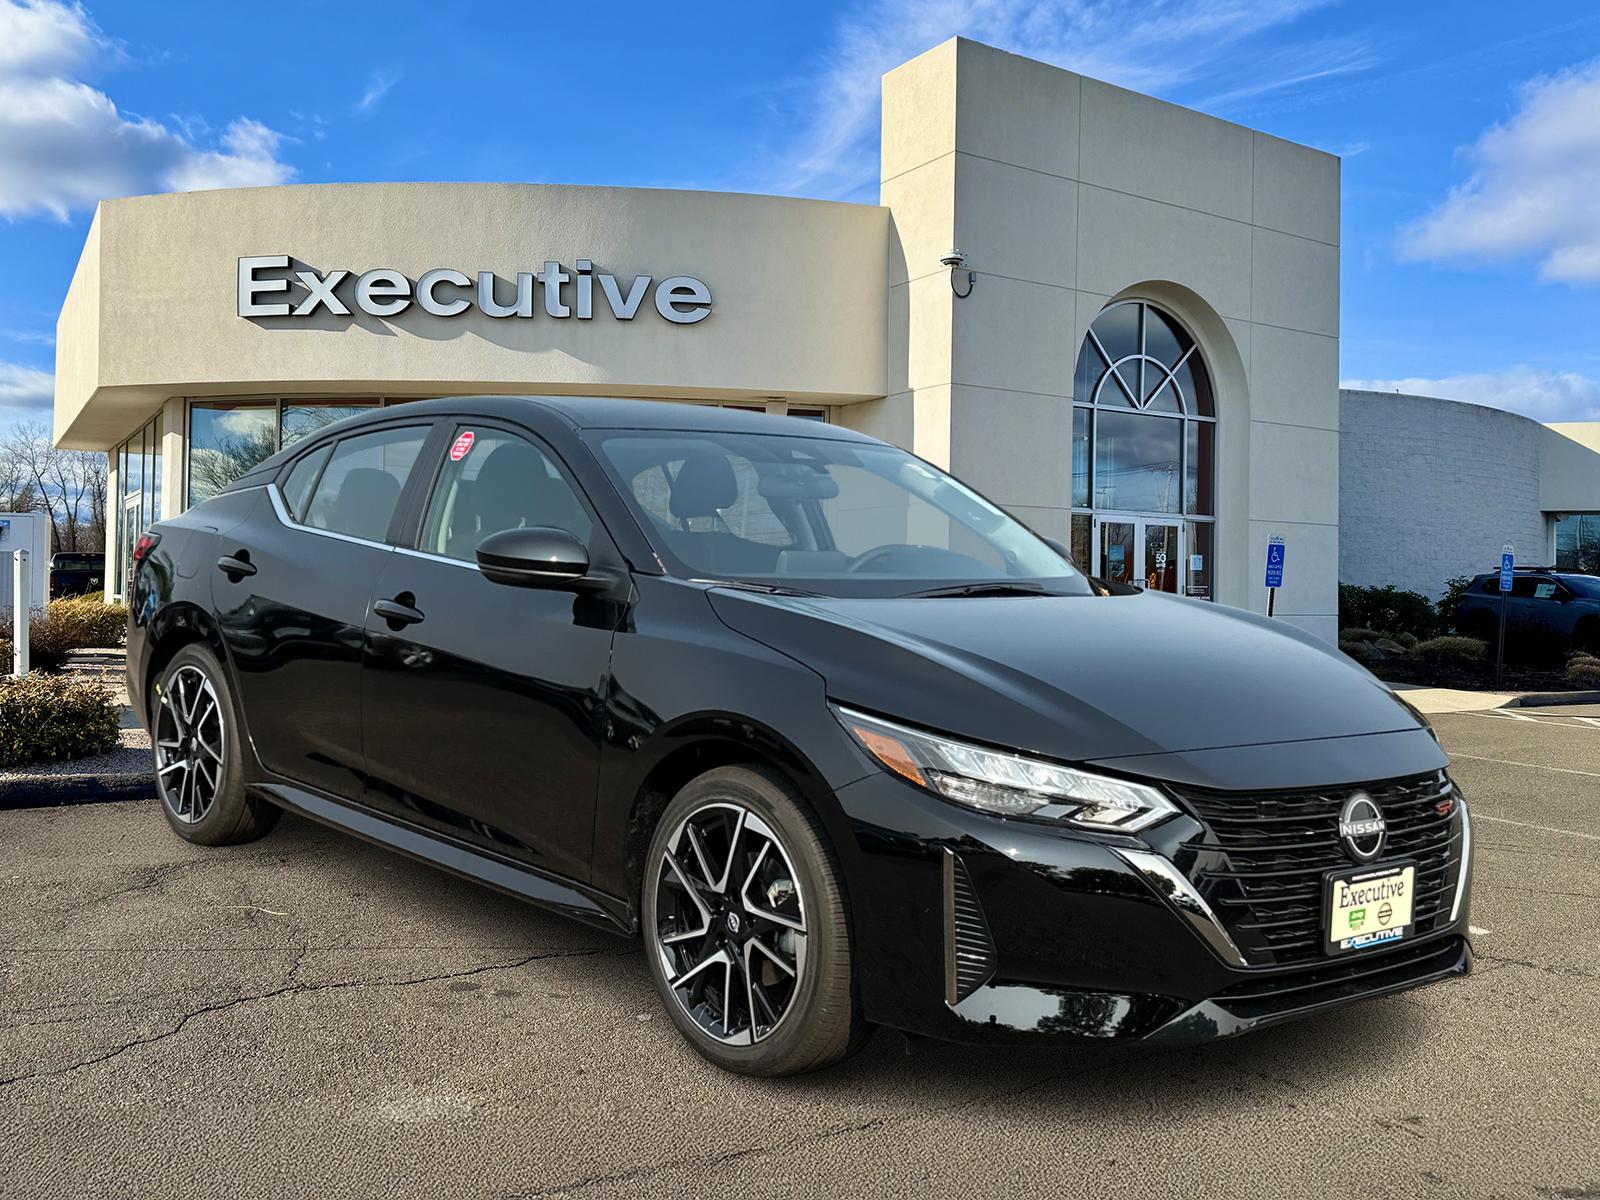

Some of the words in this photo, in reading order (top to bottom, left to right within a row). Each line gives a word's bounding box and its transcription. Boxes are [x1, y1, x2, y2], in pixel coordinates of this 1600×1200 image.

[237, 254, 712, 324] Executive
[1342, 820, 1385, 835] NISSAN
[1339, 878, 1405, 909] Executive
[1340, 926, 1404, 949] EXECUTIVE
